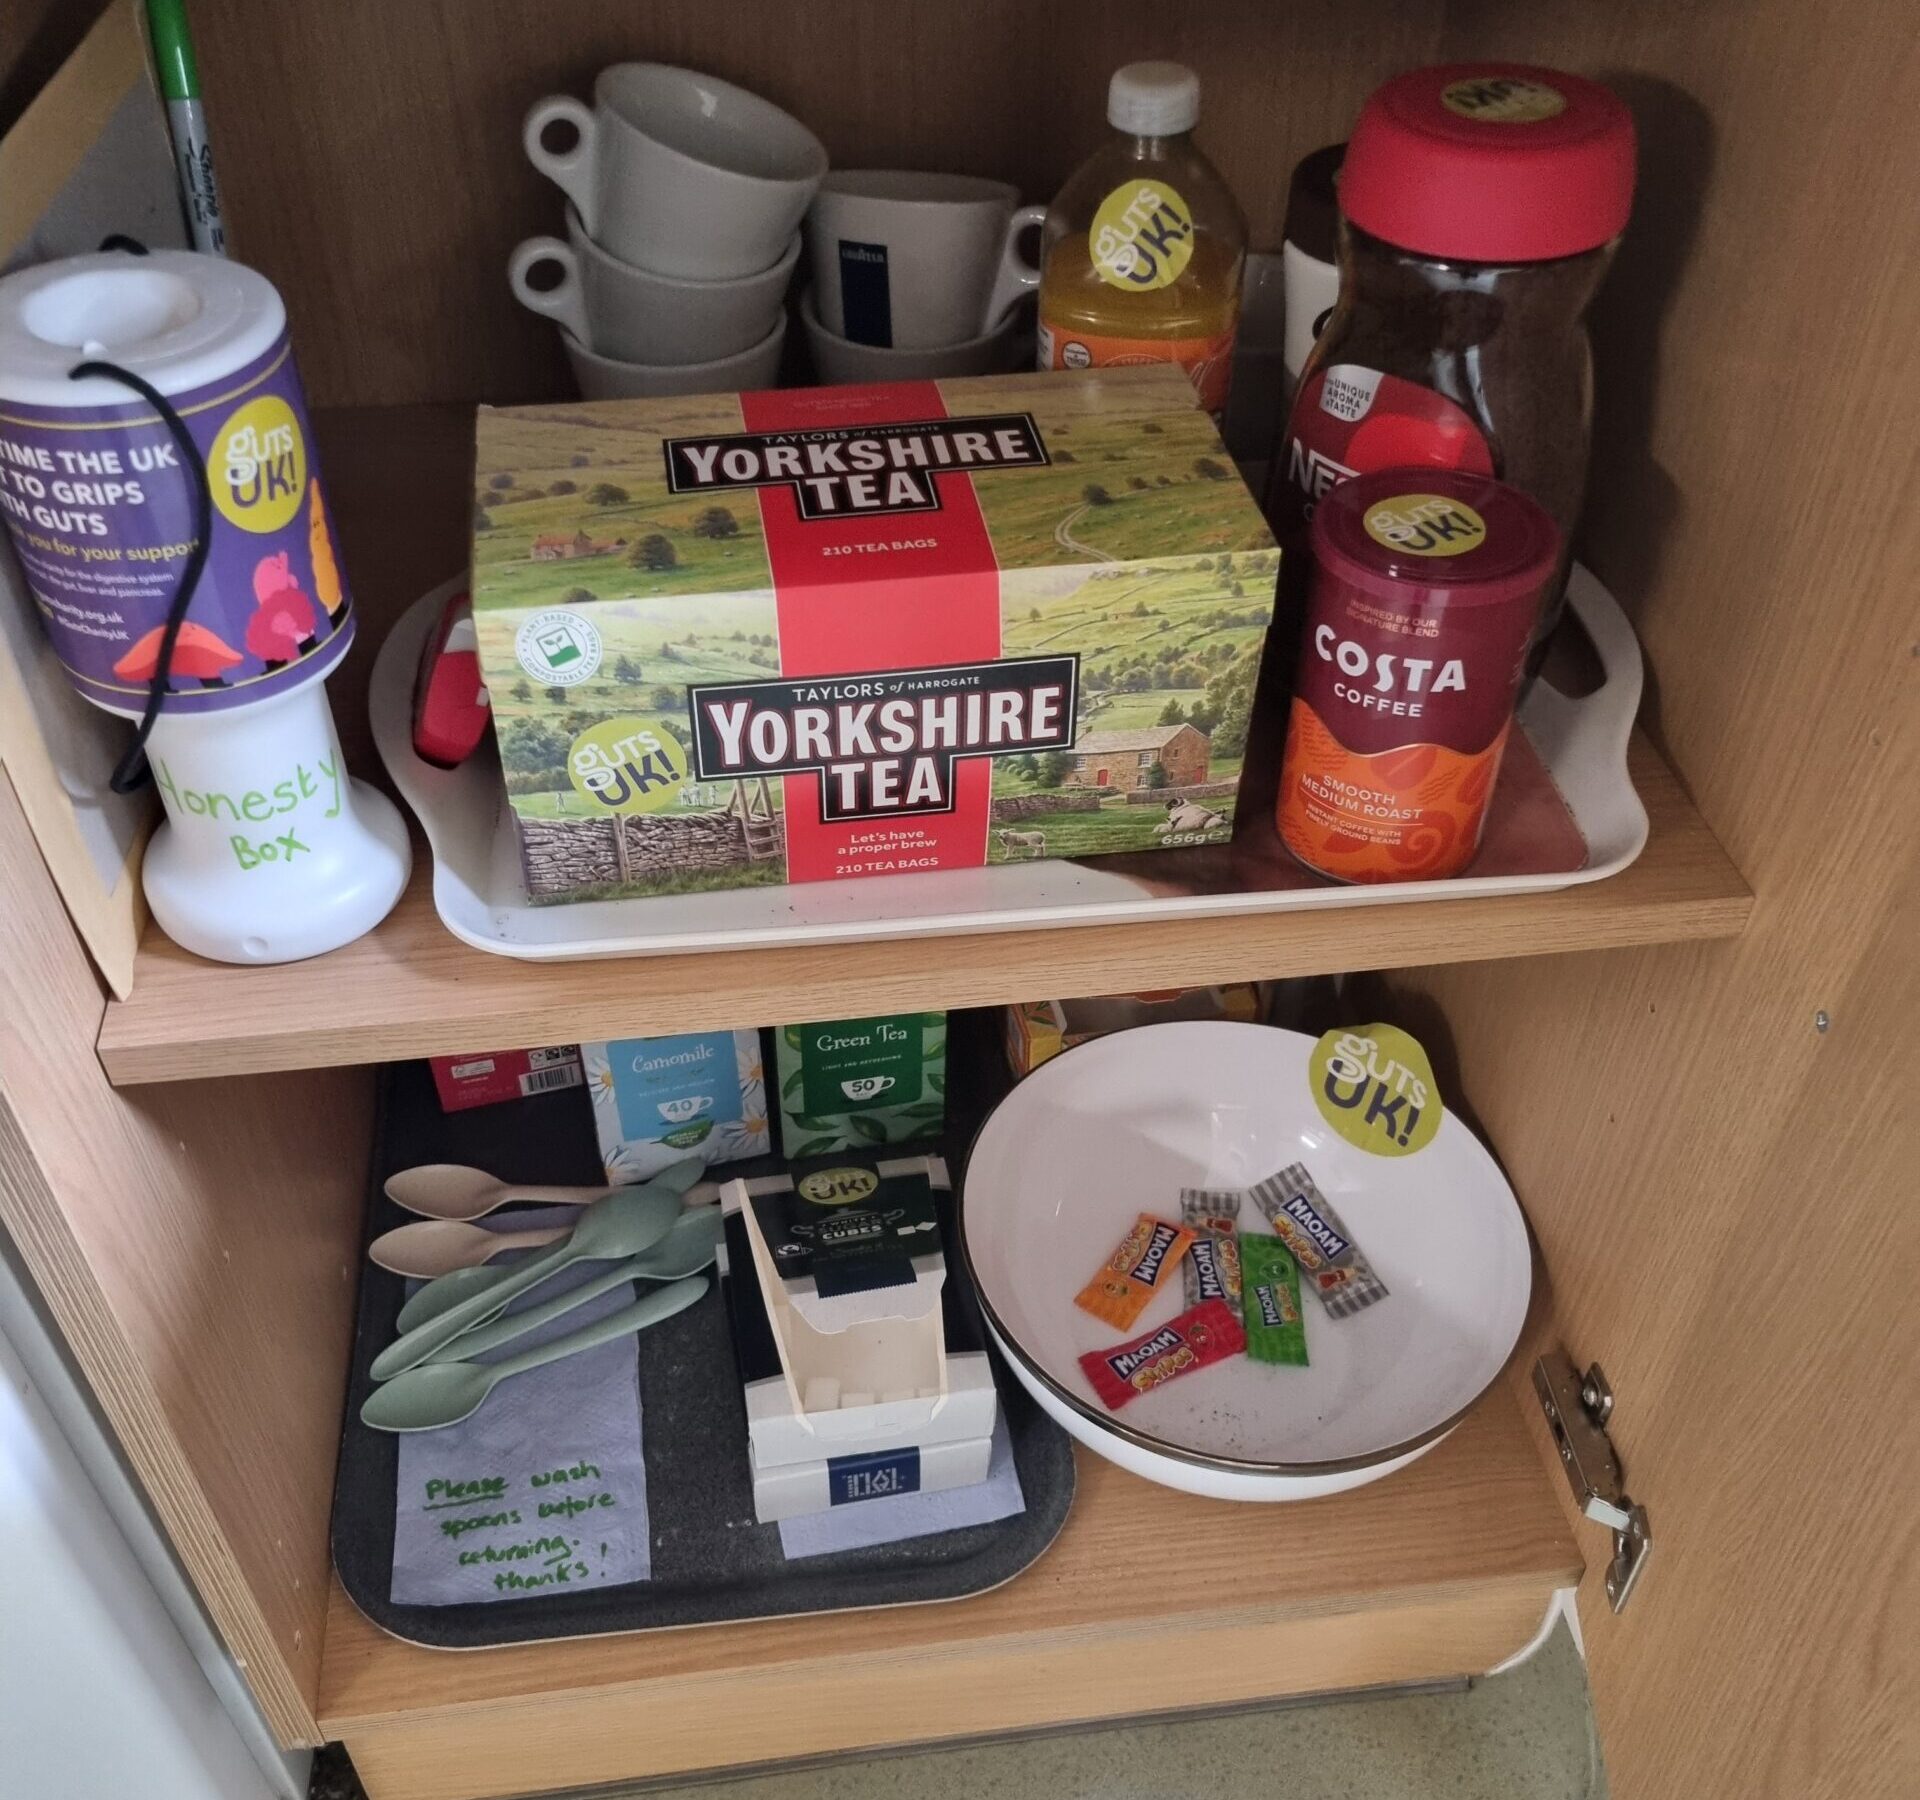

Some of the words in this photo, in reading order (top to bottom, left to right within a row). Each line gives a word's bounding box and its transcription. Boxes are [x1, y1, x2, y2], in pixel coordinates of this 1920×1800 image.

[1117, 202, 1192, 284] UK!
[1328, 387, 1360, 409] AROMA
[1334, 378, 1371, 402] UNIQUE
[1330, 399, 1356, 418] TASTE
[763, 431, 849, 445] TAYLORS
[57, 450, 124, 475] THE
[129, 441, 180, 472] UK
[683, 429, 1030, 483] YORKSHIRE
[10, 470, 46, 499] TO
[51, 480, 145, 506] GRIPS
[231, 451, 297, 508] UK!
[805, 472, 927, 511] TEA
[33, 505, 108, 536] GUTS
[1390, 511, 1482, 551] UK!
[81, 548, 122, 562] your
[822, 546, 851, 556] 210
[855, 543, 888, 554] TEA
[892, 538, 937, 550] BAGS
[1396, 614, 1410, 625] BY
[1412, 619, 1438, 628] OUR
[1401, 626, 1440, 638] BLEND
[1315, 624, 1466, 693] COSTA
[792, 682, 885, 702] TAYLORS
[889, 681, 904, 693] of
[908, 676, 980, 691] HARROGATE
[1334, 682, 1423, 718] COFFEE
[709, 687, 1061, 766] YORKSHIRE
[153, 748, 341, 822] Honesty
[587, 749, 681, 806] UK!
[830, 757, 944, 810] TEA
[1323, 775, 1396, 805] SMOOTH
[1302, 773, 1359, 812] MEDIUM
[1363, 804, 1424, 820] ROAST
[851, 832, 886, 844] Let's
[889, 830, 924, 840] have
[1307, 803, 1338, 823] INSTANT
[1340, 820, 1375, 835] COFFEE
[1377, 828, 1401, 838] WITH
[1330, 824, 1369, 841] GROUND
[1370, 836, 1402, 846] BEANS
[229, 827, 311, 870] Box
[838, 846, 845, 855] a
[849, 842, 898, 856] proper
[901, 839, 937, 849] brew
[836, 864, 862, 875] 210
[865, 861, 895, 872] TEA
[898, 857, 938, 868] BAGS
[817, 1034, 871, 1052] Green
[876, 1024, 908, 1042] Tea
[632, 1043, 714, 1073] Camomile
[852, 1079, 875, 1093] 50
[1323, 1059, 1421, 1147] UK!
[667, 1100, 693, 1113] 40
[810, 1177, 872, 1200] UK!
[822, 1225, 882, 1240] CUBES
[1288, 1198, 1347, 1256] MAOAM
[1134, 1226, 1176, 1282] MAOAM
[1192, 1243, 1225, 1297] MAOAM
[1256, 1286, 1280, 1324] MAOAM
[1112, 1332, 1182, 1377] MAOAM
[425, 1475, 509, 1500] Please
[530, 1460, 601, 1488] wash
[440, 1510, 523, 1540] spoons
[537, 1492, 616, 1519] before
